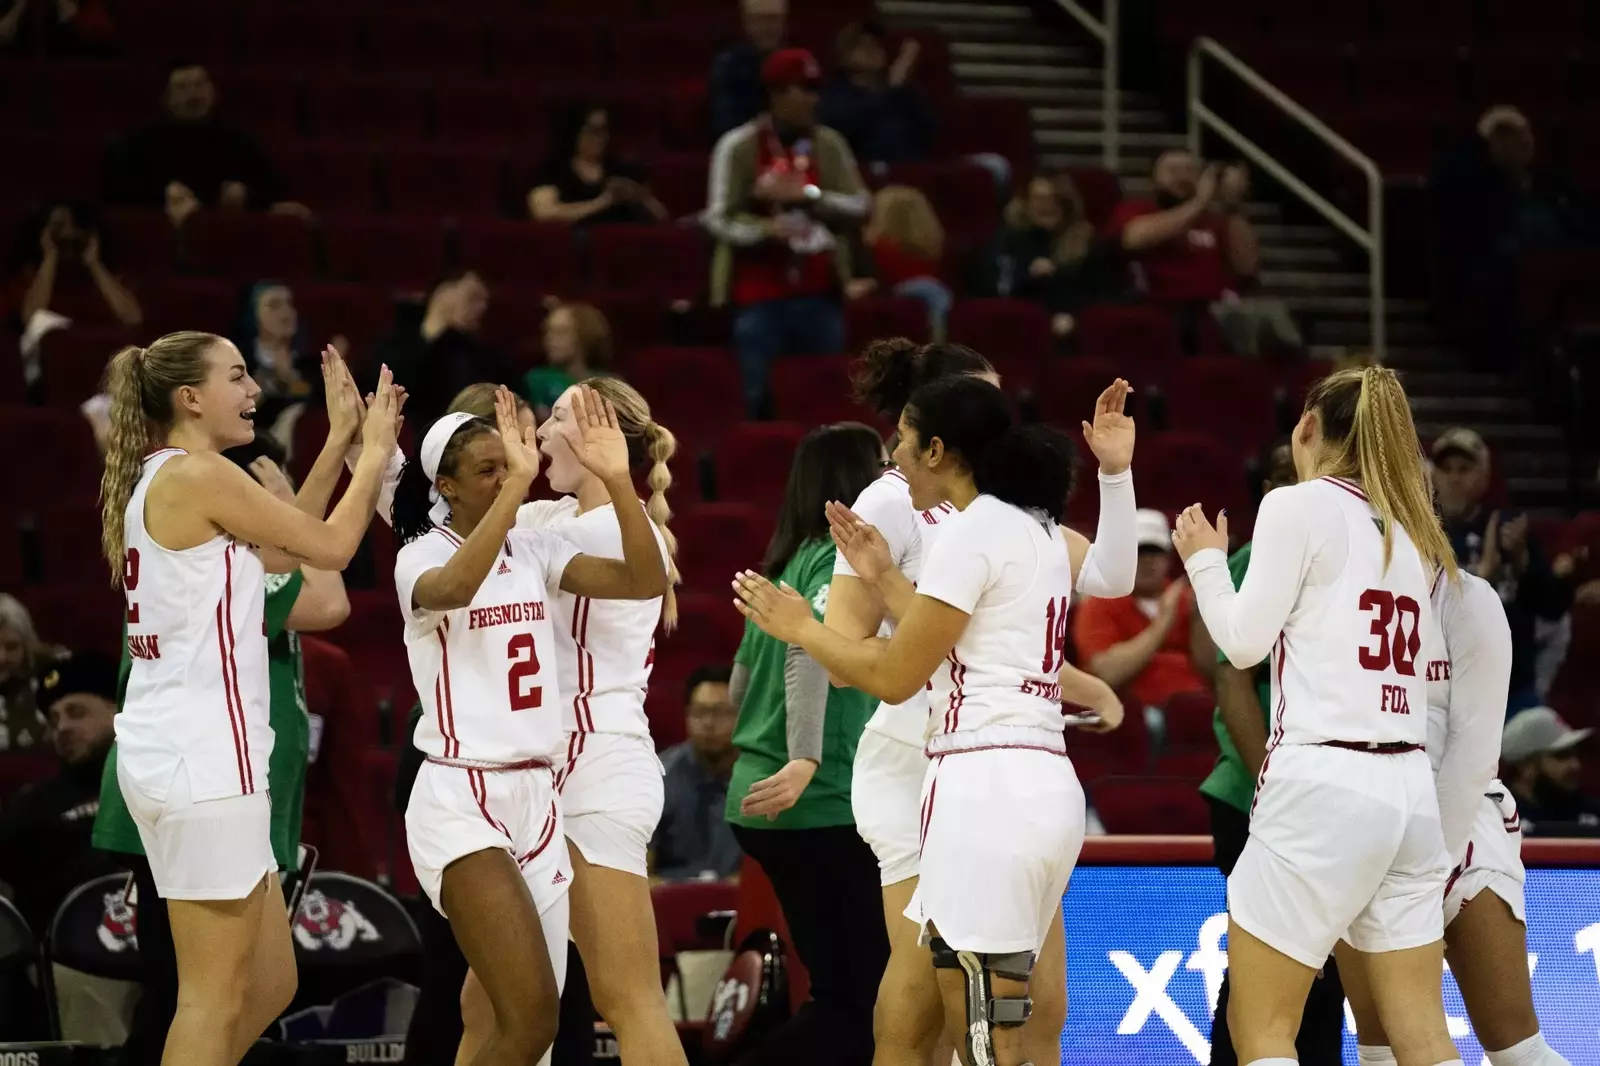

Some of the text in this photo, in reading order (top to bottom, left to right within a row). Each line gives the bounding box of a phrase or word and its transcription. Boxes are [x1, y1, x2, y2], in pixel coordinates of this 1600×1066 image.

[469, 602, 523, 630] FRESNO
[1042, 596, 1067, 673] 14
[1359, 588, 1421, 677] 30
[508, 632, 542, 712] 2
[1381, 684, 1410, 715] FOX
